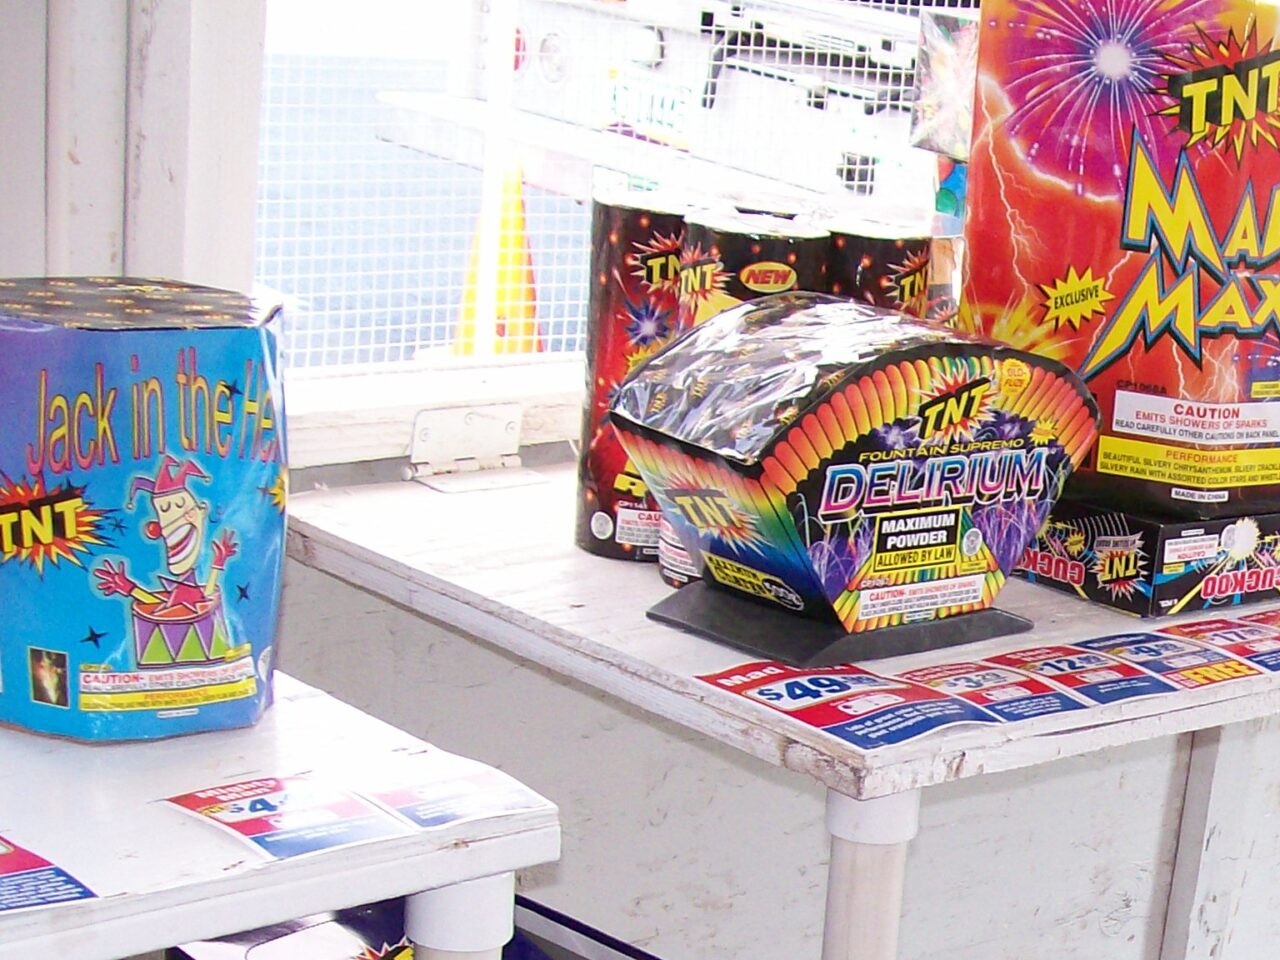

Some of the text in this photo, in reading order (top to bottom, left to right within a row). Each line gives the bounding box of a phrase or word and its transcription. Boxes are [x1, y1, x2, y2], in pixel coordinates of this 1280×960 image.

[680, 262, 717, 293] TNT
[745, 269, 793, 286] NEW
[1053, 284, 1101, 312] EXCLUSIVE
[27, 362, 120, 476] Jack
[130, 354, 167, 461] in
[175, 346, 235, 459] the
[921, 383, 992, 440] TNT
[1135, 410, 1269, 431] EMITS SHOWERS OF SPARKS
[1173, 403, 1241, 420] CAUTION
[1114, 418, 1136, 430] READ
[1136, 422, 1178, 437] CAREFULLY
[1178, 429, 1204, 441] OTHER
[858, 438, 1025, 463] FOUNTAIN SUPREMO
[1102, 451, 1142, 466] BEAUTIFUL
[1143, 457, 1172, 469] SILVERY
[1165, 449, 1239, 464] PERFORMANCE
[818, 447, 1050, 524] DELIRIUM
[1167, 471, 1208, 486] ASSORTED
[1174, 490, 1197, 500] MADE
[674, 495, 744, 529] TNT
[881, 512, 957, 535] MAXIMUM
[0, 497, 85, 553] TNT
[886, 530, 949, 550] POWDER
[876, 545, 955, 568] ALLOWED BY LAW
[1018, 548, 1086, 586] CUCK
[1100, 552, 1139, 582] TNT
[717, 666, 785, 687] Mad
[1183, 659, 1252, 684] FREE
